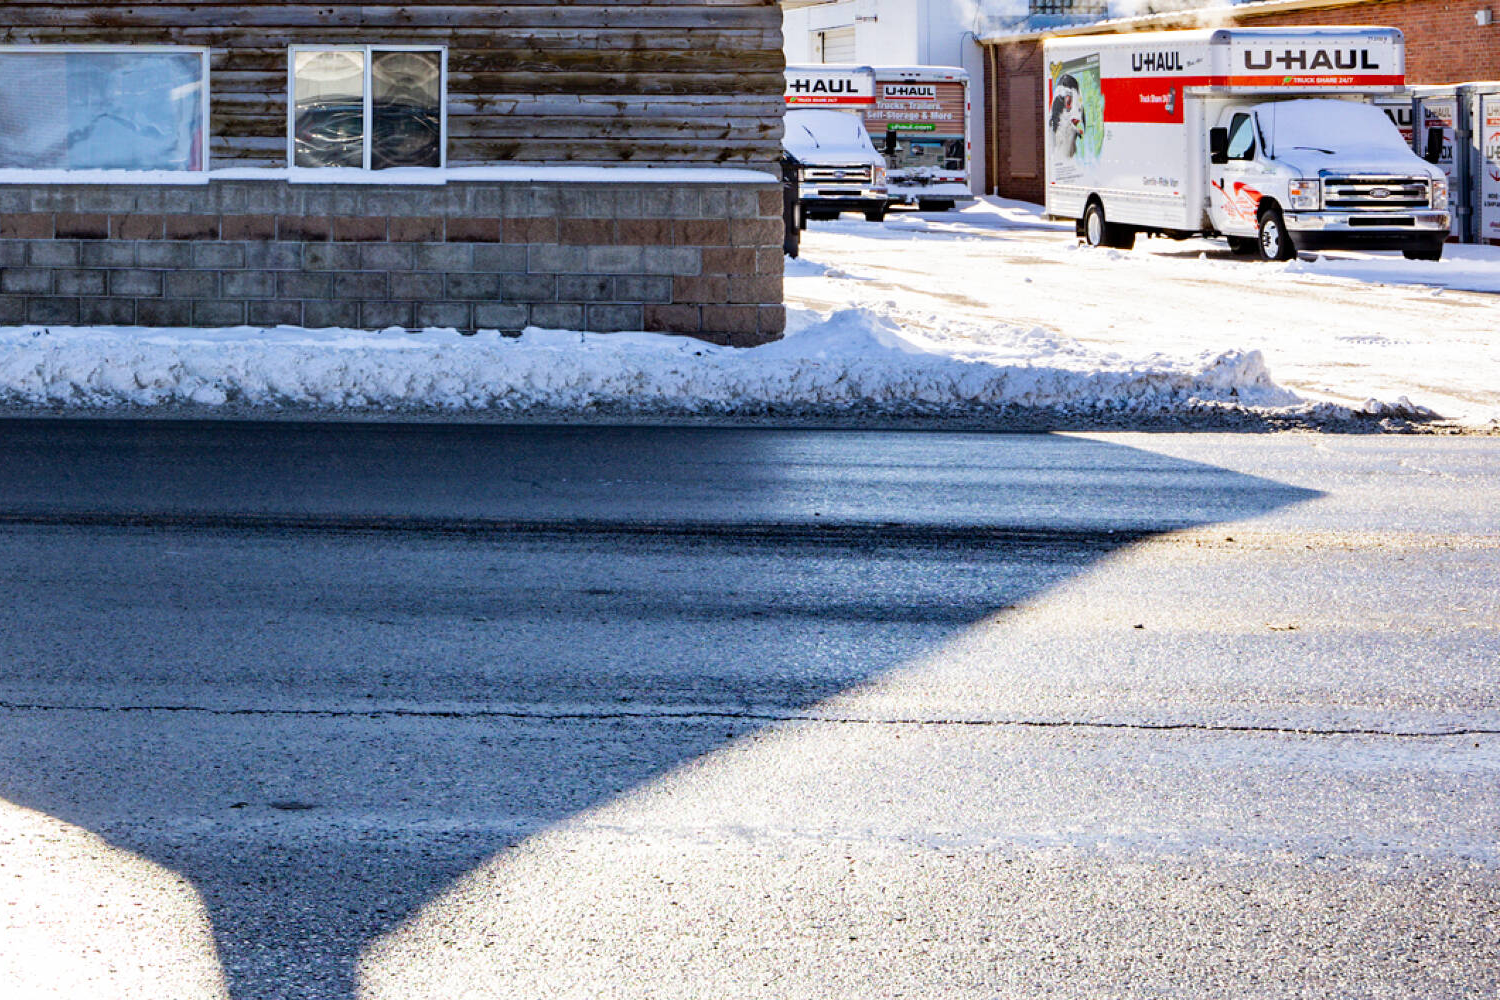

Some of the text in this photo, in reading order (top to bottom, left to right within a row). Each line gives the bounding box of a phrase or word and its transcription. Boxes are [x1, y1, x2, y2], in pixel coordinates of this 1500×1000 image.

[1132, 51, 1183, 72] U-HAUL
[1244, 49, 1379, 70] U-HAUL
[885, 87, 934, 96] U-HAUL
